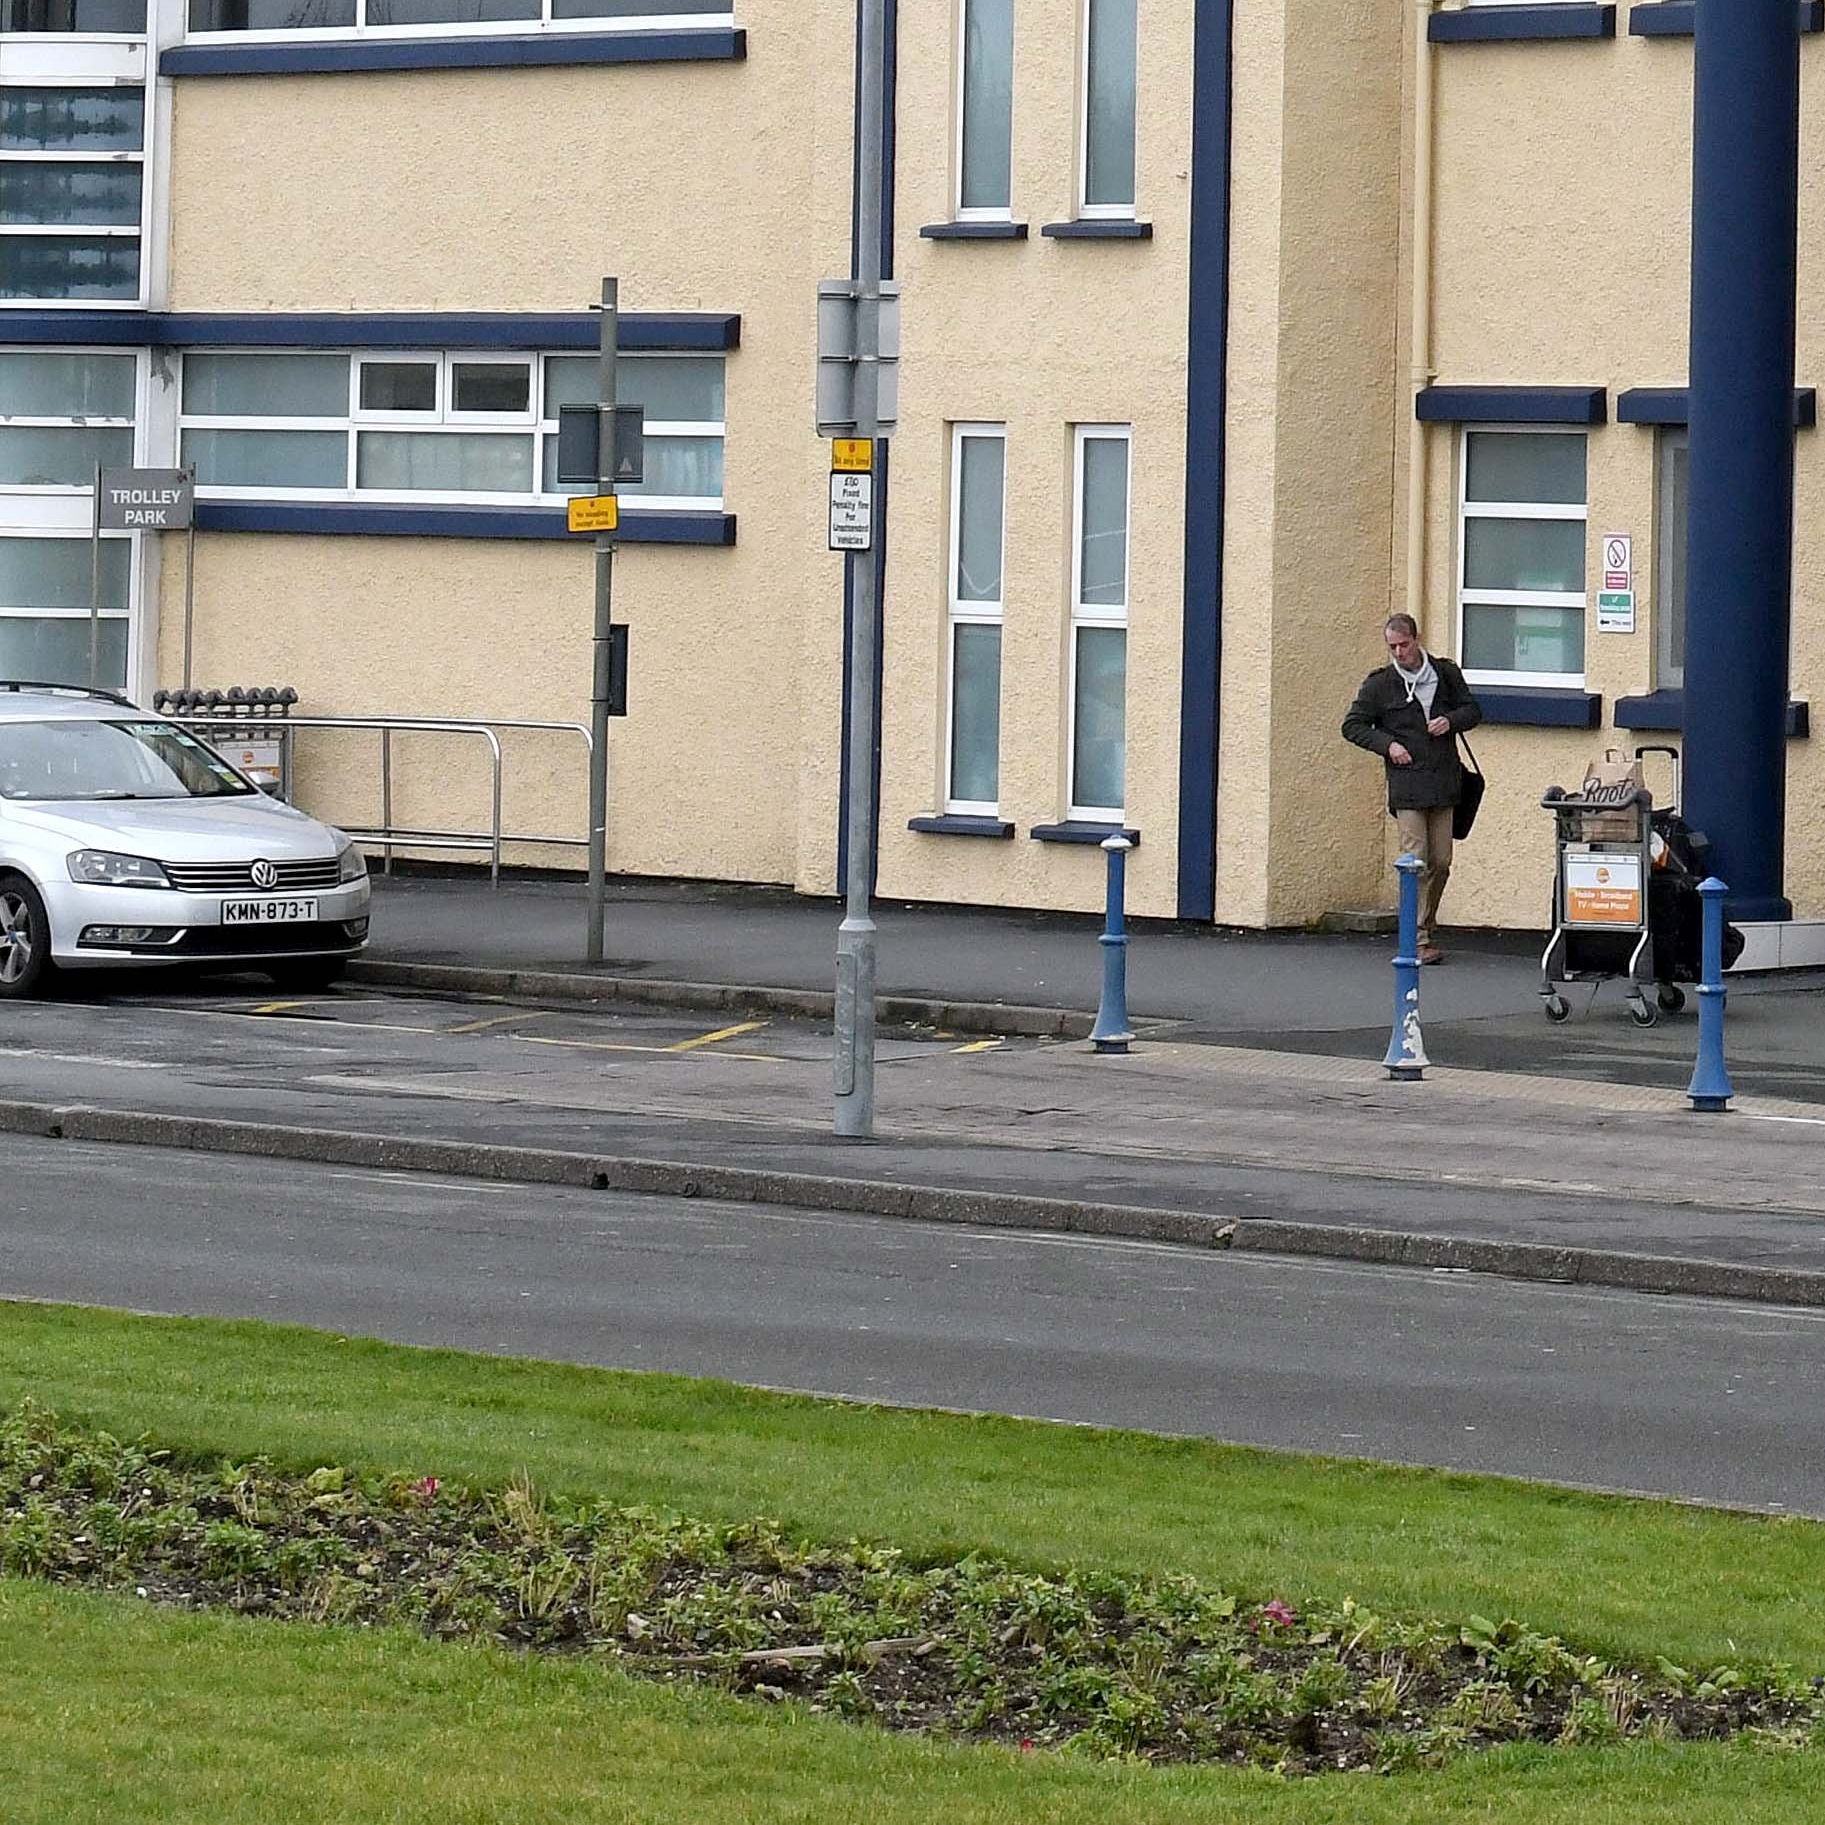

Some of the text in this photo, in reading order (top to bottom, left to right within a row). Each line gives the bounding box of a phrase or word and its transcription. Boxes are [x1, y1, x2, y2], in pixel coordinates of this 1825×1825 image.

[110, 489, 181, 504] TROLLEY
[124, 509, 166, 524] PARK
[1584, 777, 1637, 805] Root
[226, 900, 314, 921] KMN-873-T
